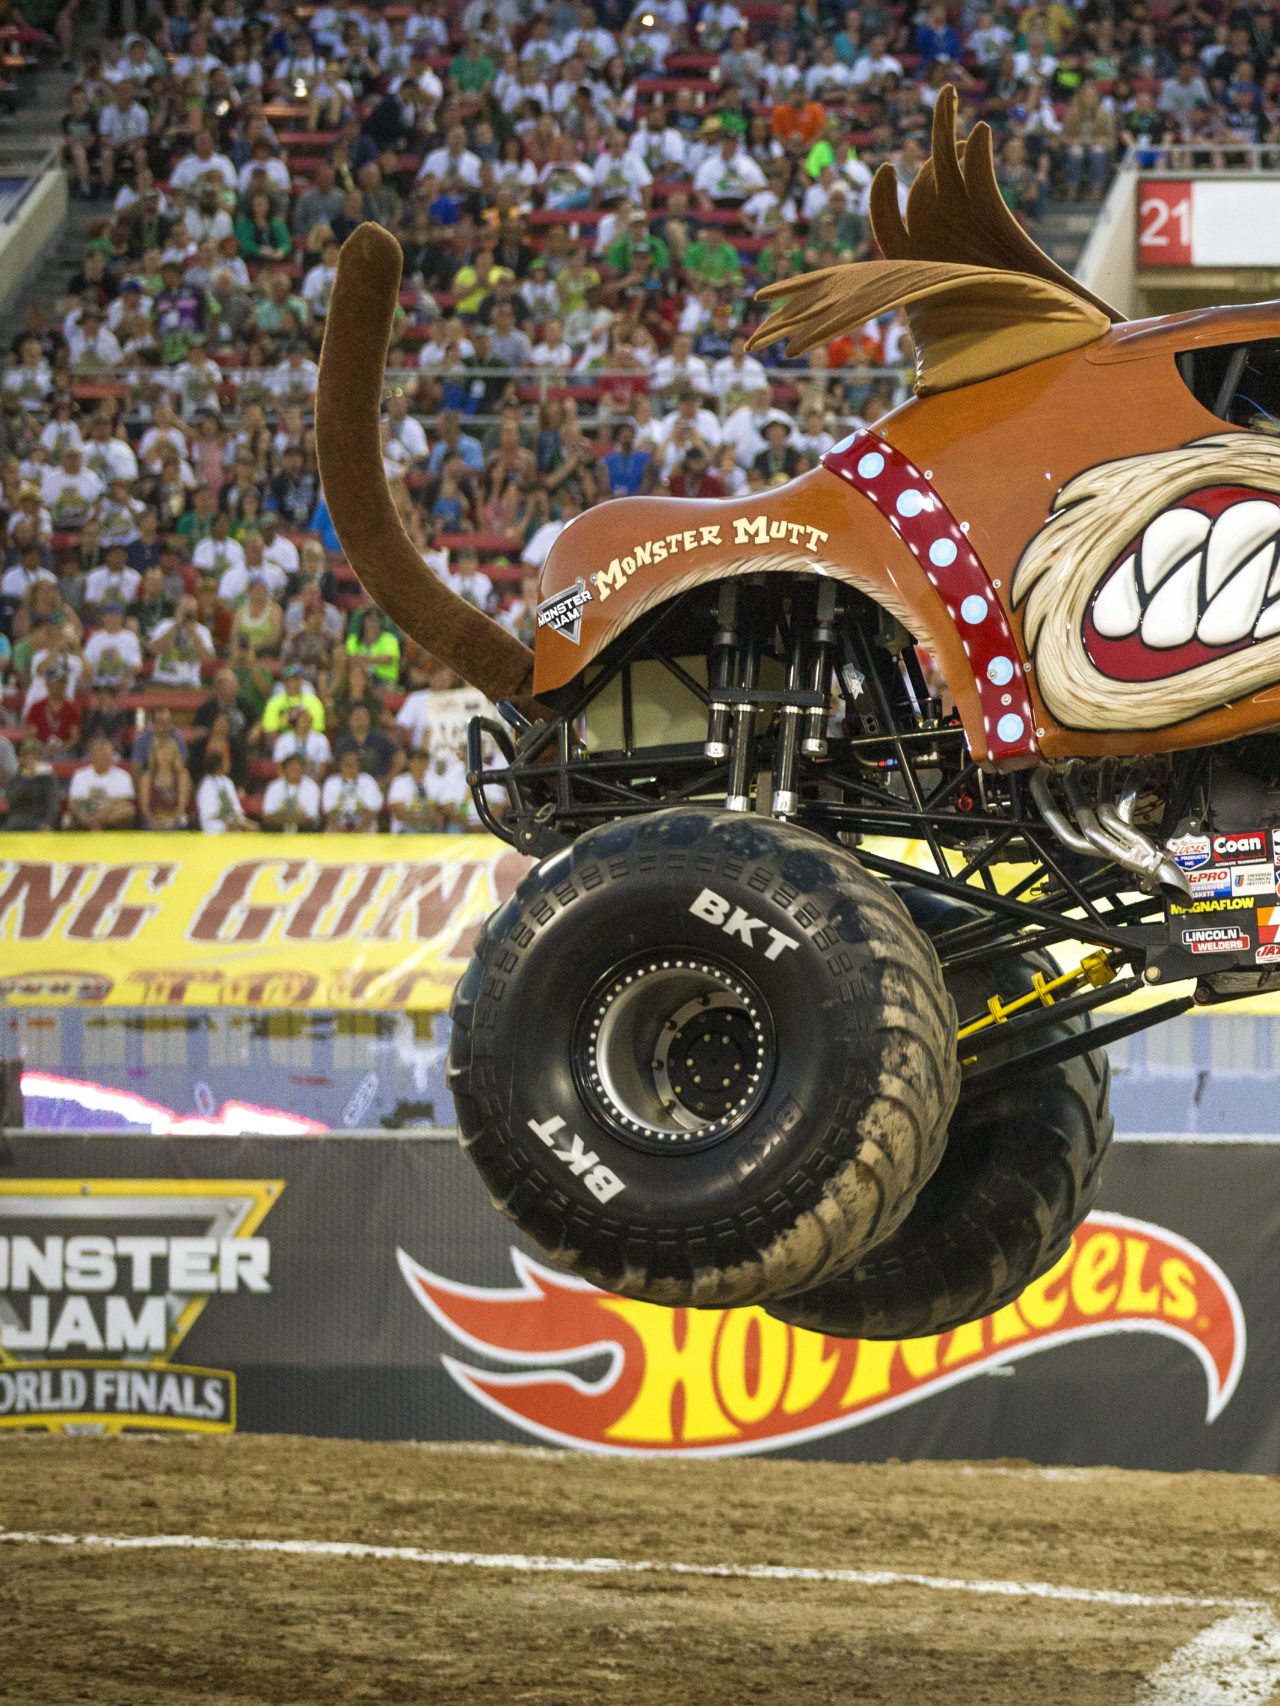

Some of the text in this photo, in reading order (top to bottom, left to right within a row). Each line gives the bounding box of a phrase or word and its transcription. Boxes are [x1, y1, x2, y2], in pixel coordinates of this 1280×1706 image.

[1140, 198, 1191, 246] 21
[594, 524, 722, 602] MONSTER
[538, 590, 592, 627] MONSTER
[553, 608, 580, 629] JAM
[1174, 844, 1206, 855] LUCAS
[1213, 837, 1262, 854] Coan
[1187, 871, 1228, 884] L-PRO
[689, 887, 800, 962] BKT
[1185, 929, 1237, 942] LINCOLN
[1198, 941, 1243, 951] WELDERS
[527, 1114, 626, 1204] BKT
[0, 1237, 271, 1292] NSTER
[0, 1296, 167, 1352] JAM
[0, 1369, 224, 1418] ORLD FINALS
